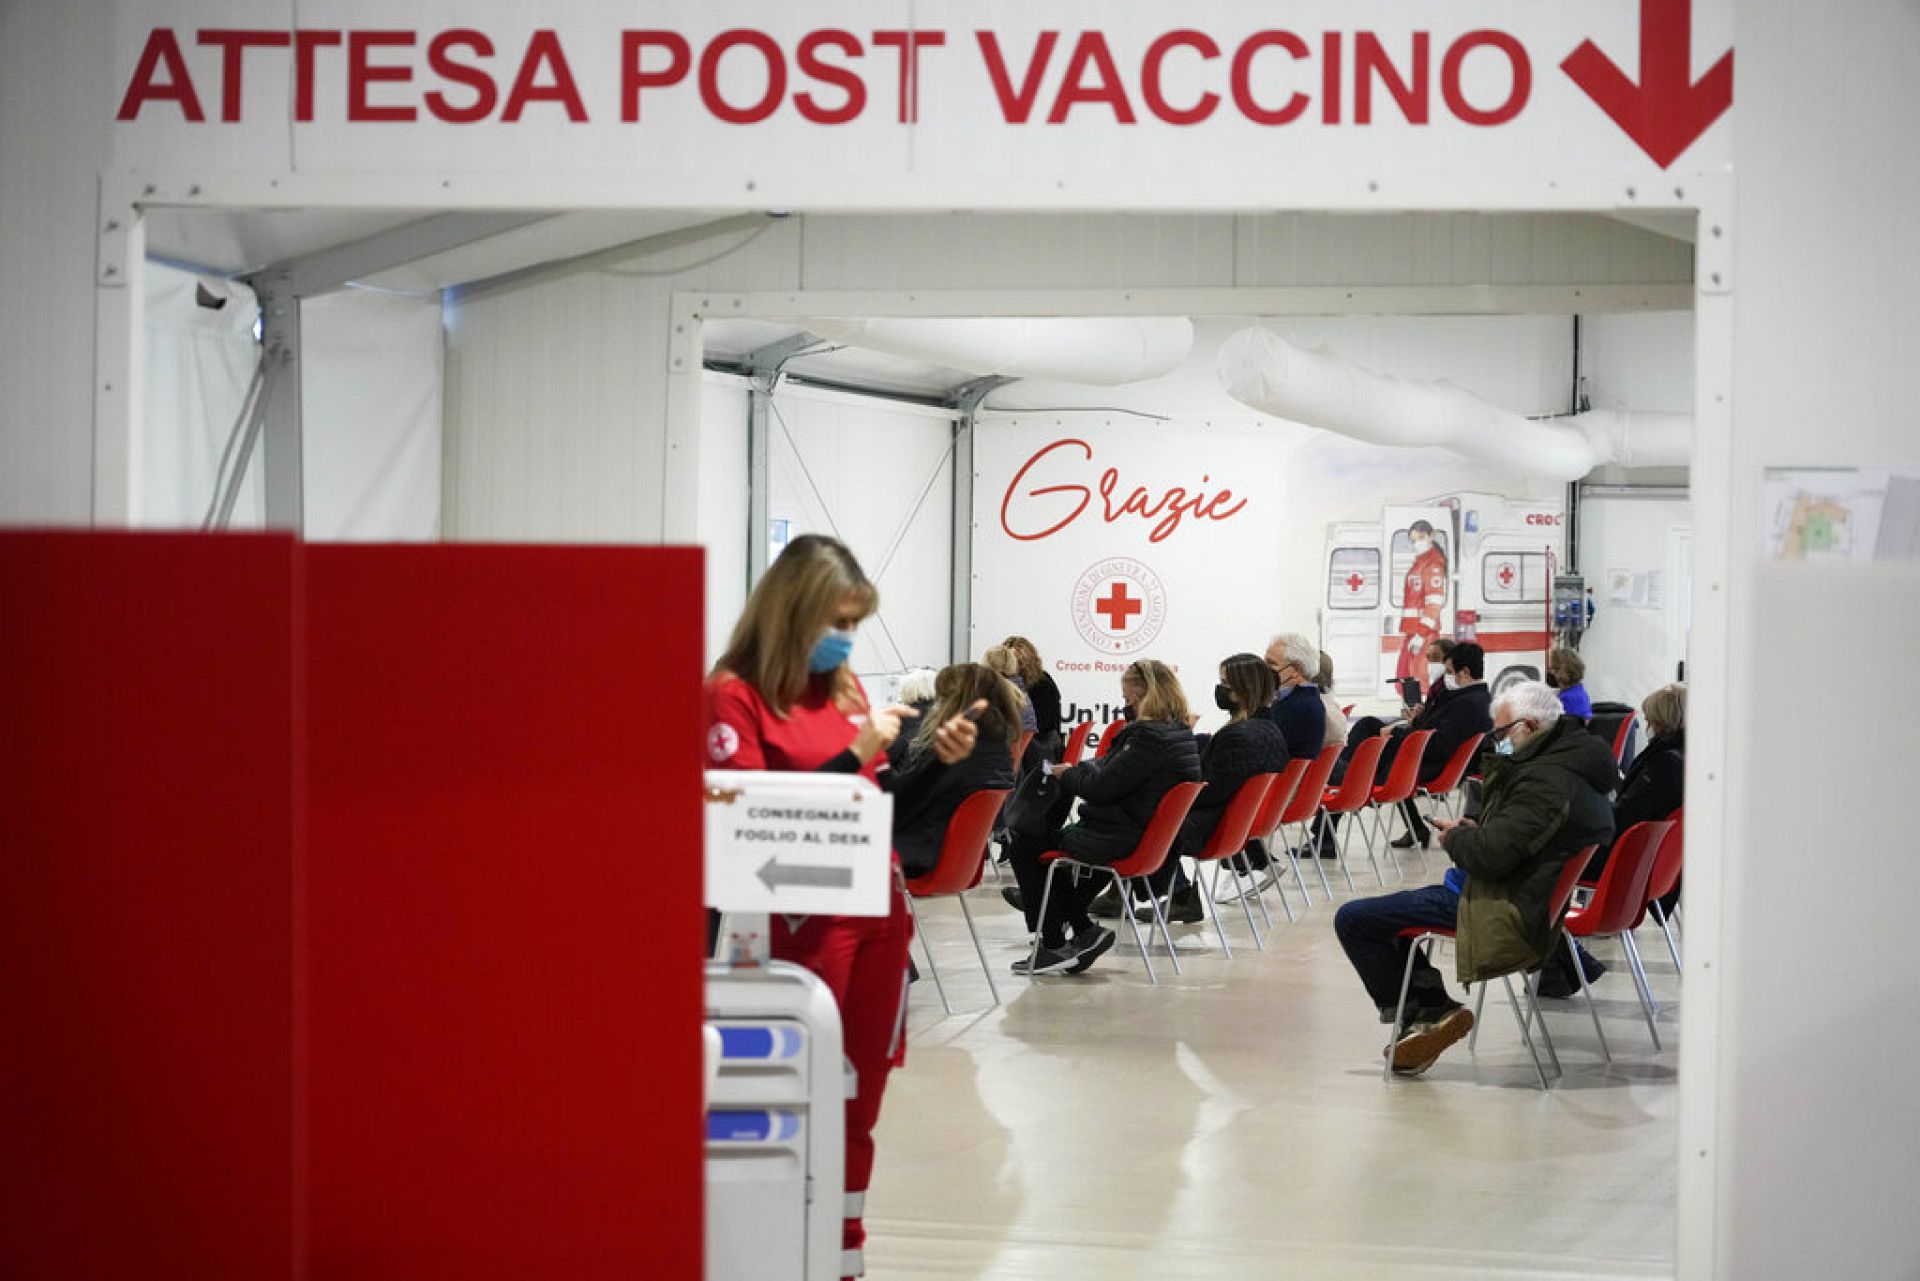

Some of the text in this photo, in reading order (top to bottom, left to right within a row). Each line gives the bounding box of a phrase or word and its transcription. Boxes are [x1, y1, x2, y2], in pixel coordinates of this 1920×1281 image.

[119, 28, 1533, 127] ATTESA POST VACCINO
[1001, 438, 1248, 543] Grazie
[1055, 660, 1092, 672] Croce
[1058, 703, 1125, 724] Un'It
[747, 807, 861, 823] CONSEGNARE
[735, 829, 871, 846] FOGLIO AL DESK
